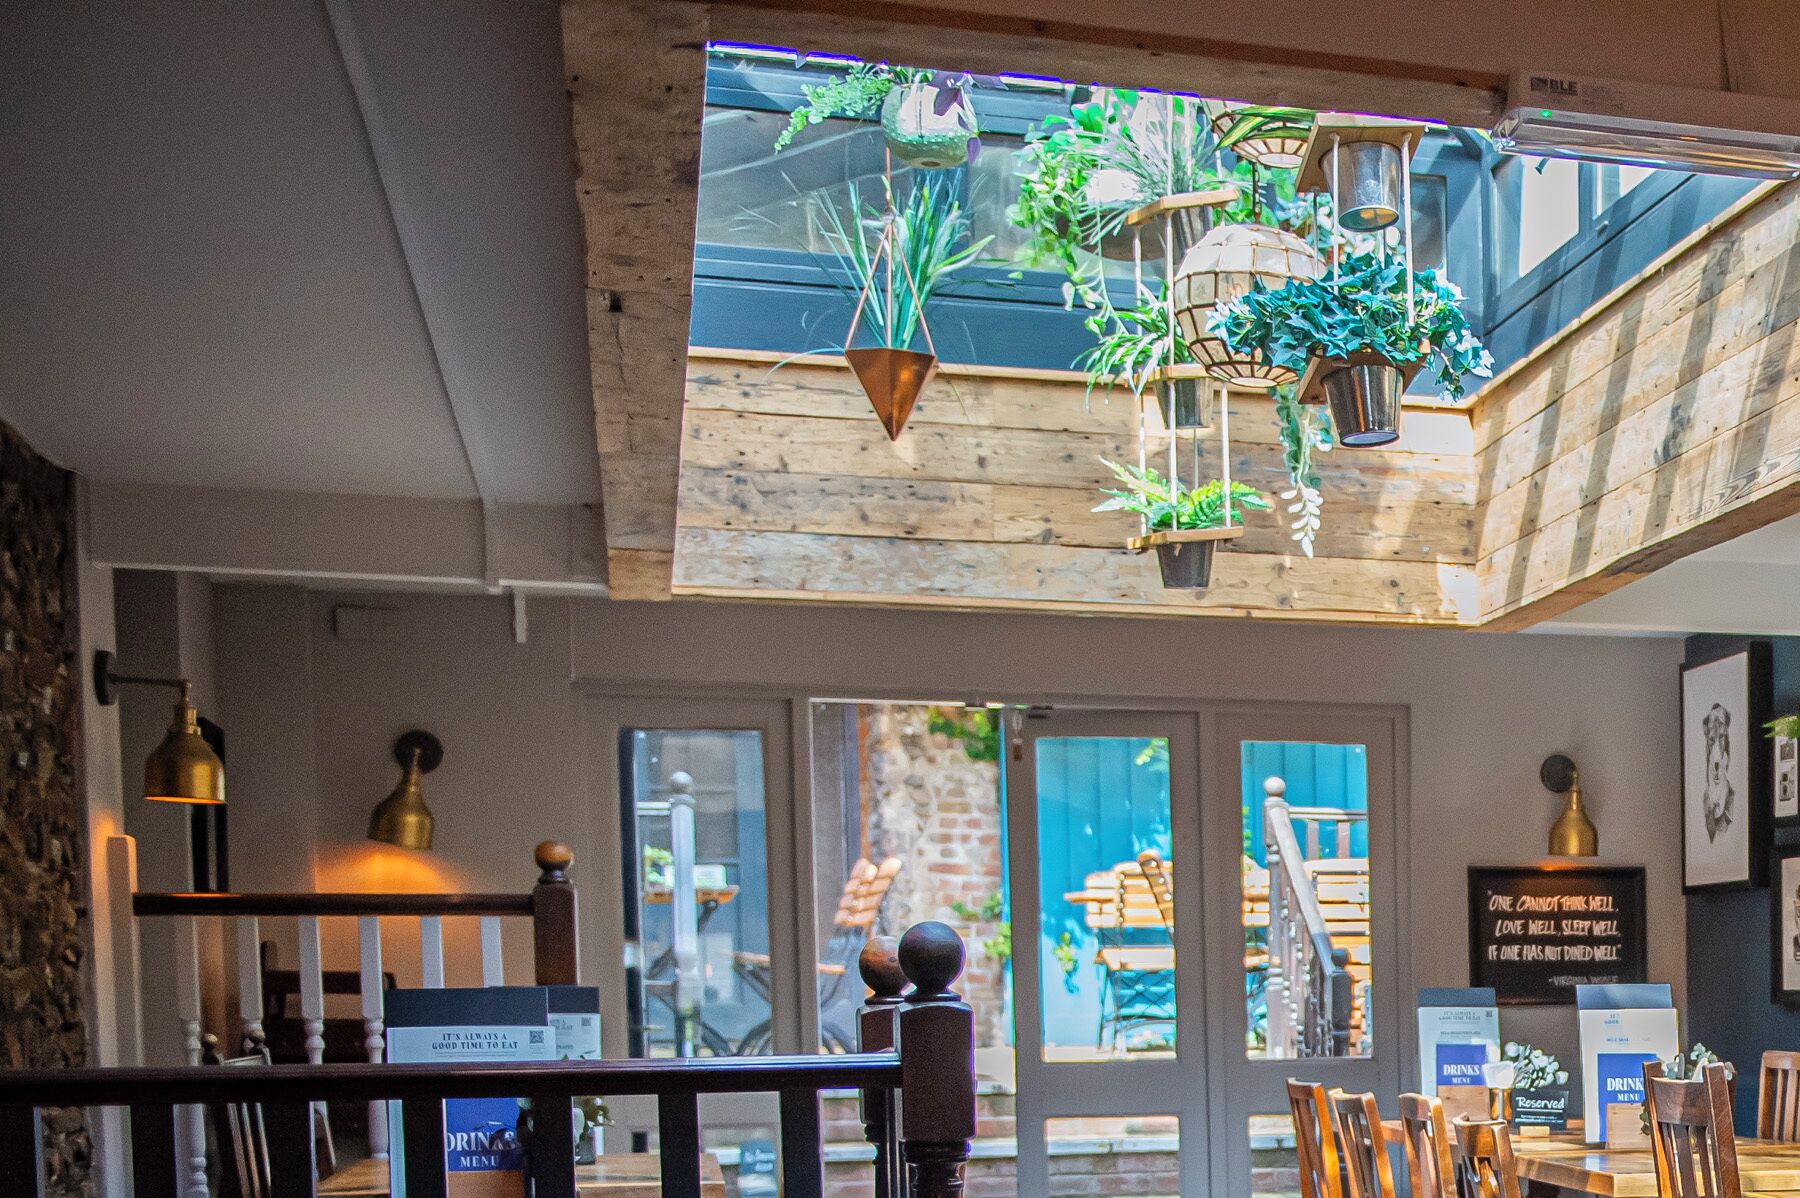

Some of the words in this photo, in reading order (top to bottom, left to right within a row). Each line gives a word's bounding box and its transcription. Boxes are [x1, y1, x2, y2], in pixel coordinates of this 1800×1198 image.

[1516, 895, 1561, 912] CANNOT
[1560, 895, 1589, 912] THINK
[1495, 920, 1525, 936] LOVE
[1562, 920, 1592, 936] SLEEP
[1488, 944, 1498, 960] IF
[1501, 945, 1520, 960] ONE
[1523, 944, 1543, 960] HAS
[1545, 945, 1564, 960] NOT
[1565, 945, 1593, 960] DINED
[442, 1033, 461, 1041] IT'S
[463, 1032, 499, 1041] ALWAYS
[501, 1032, 508, 1040] A
[431, 1041, 458, 1050] GOOD
[461, 1041, 484, 1050] TIME
[487, 1041, 499, 1049] TO
[502, 1041, 518, 1049] EAT
[1443, 1064, 1480, 1076] DRINKS
[1606, 1077, 1645, 1091] DRINK
[1516, 1096, 1565, 1109] Reserved
[1617, 1093, 1640, 1101] MENU
[460, 1155, 500, 1167] MENU
